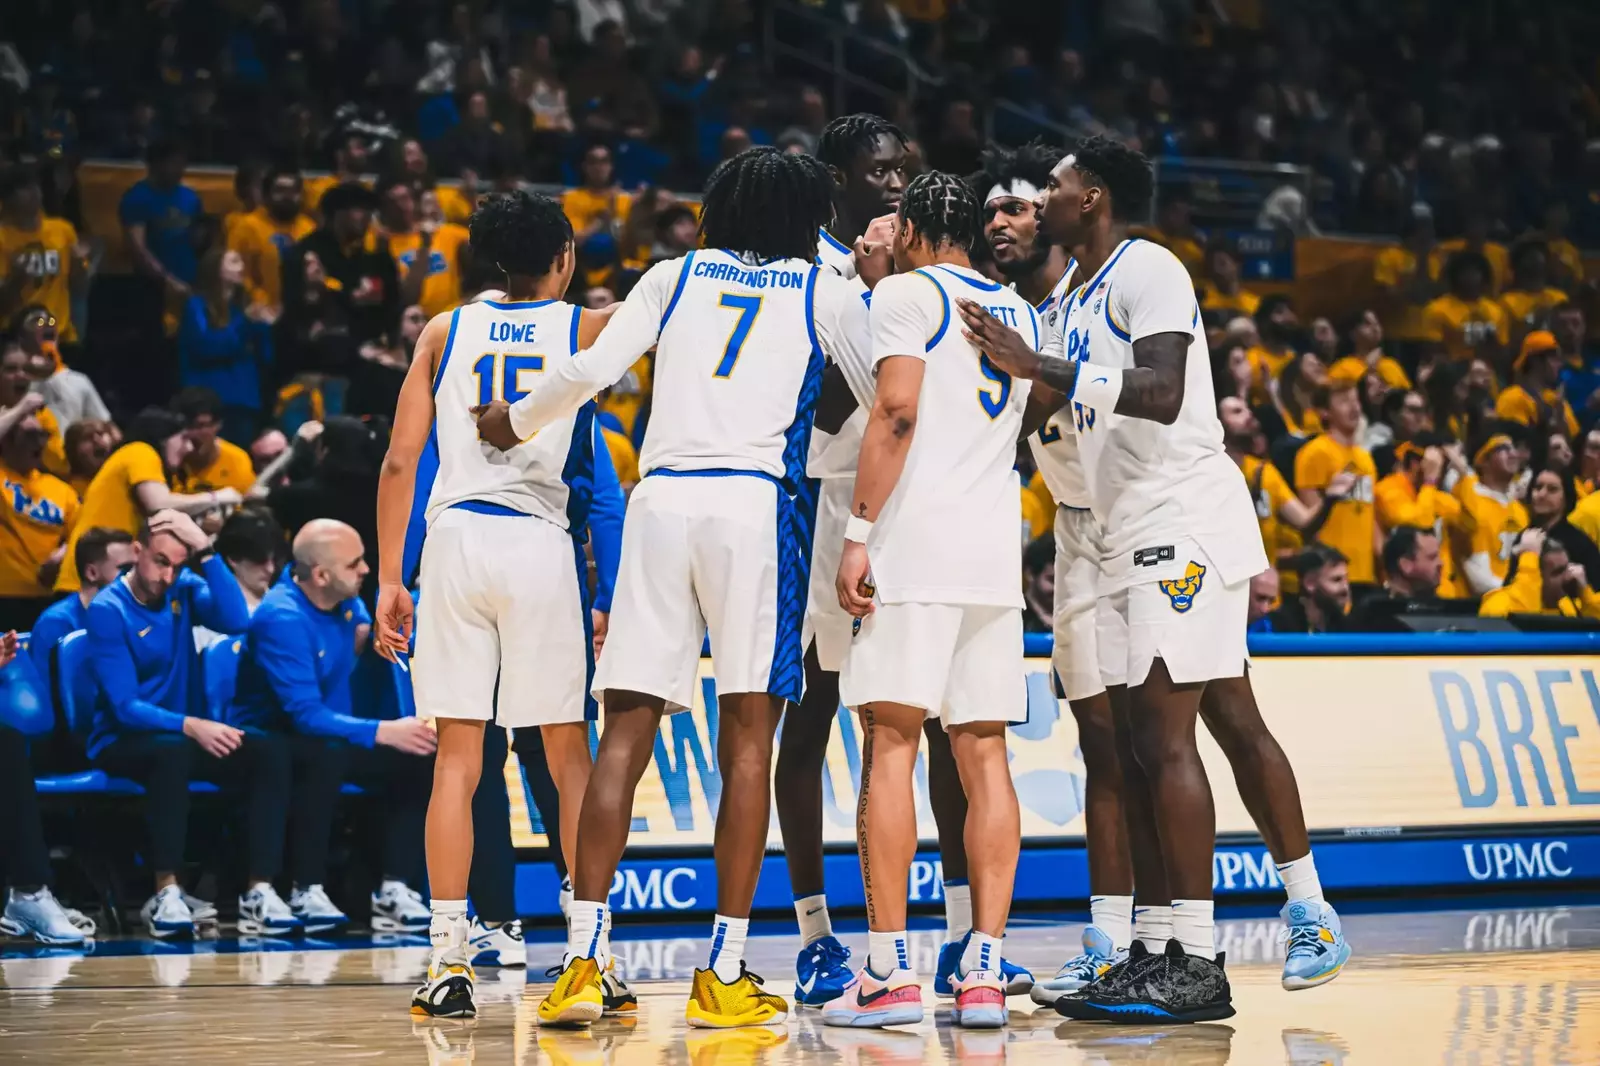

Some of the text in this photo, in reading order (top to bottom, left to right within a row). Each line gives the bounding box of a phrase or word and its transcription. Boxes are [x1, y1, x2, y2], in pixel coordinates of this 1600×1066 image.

[694, 261, 803, 289] CARRINGTON
[489, 321, 536, 343] LOWE
[712, 291, 764, 380] 7
[860, 797, 869, 816] NO
[860, 830, 872, 889] PROGRESS
[1463, 841, 1573, 880] UPMC
[606, 867, 697, 909] PMC
[866, 891, 877, 925] SLOW
